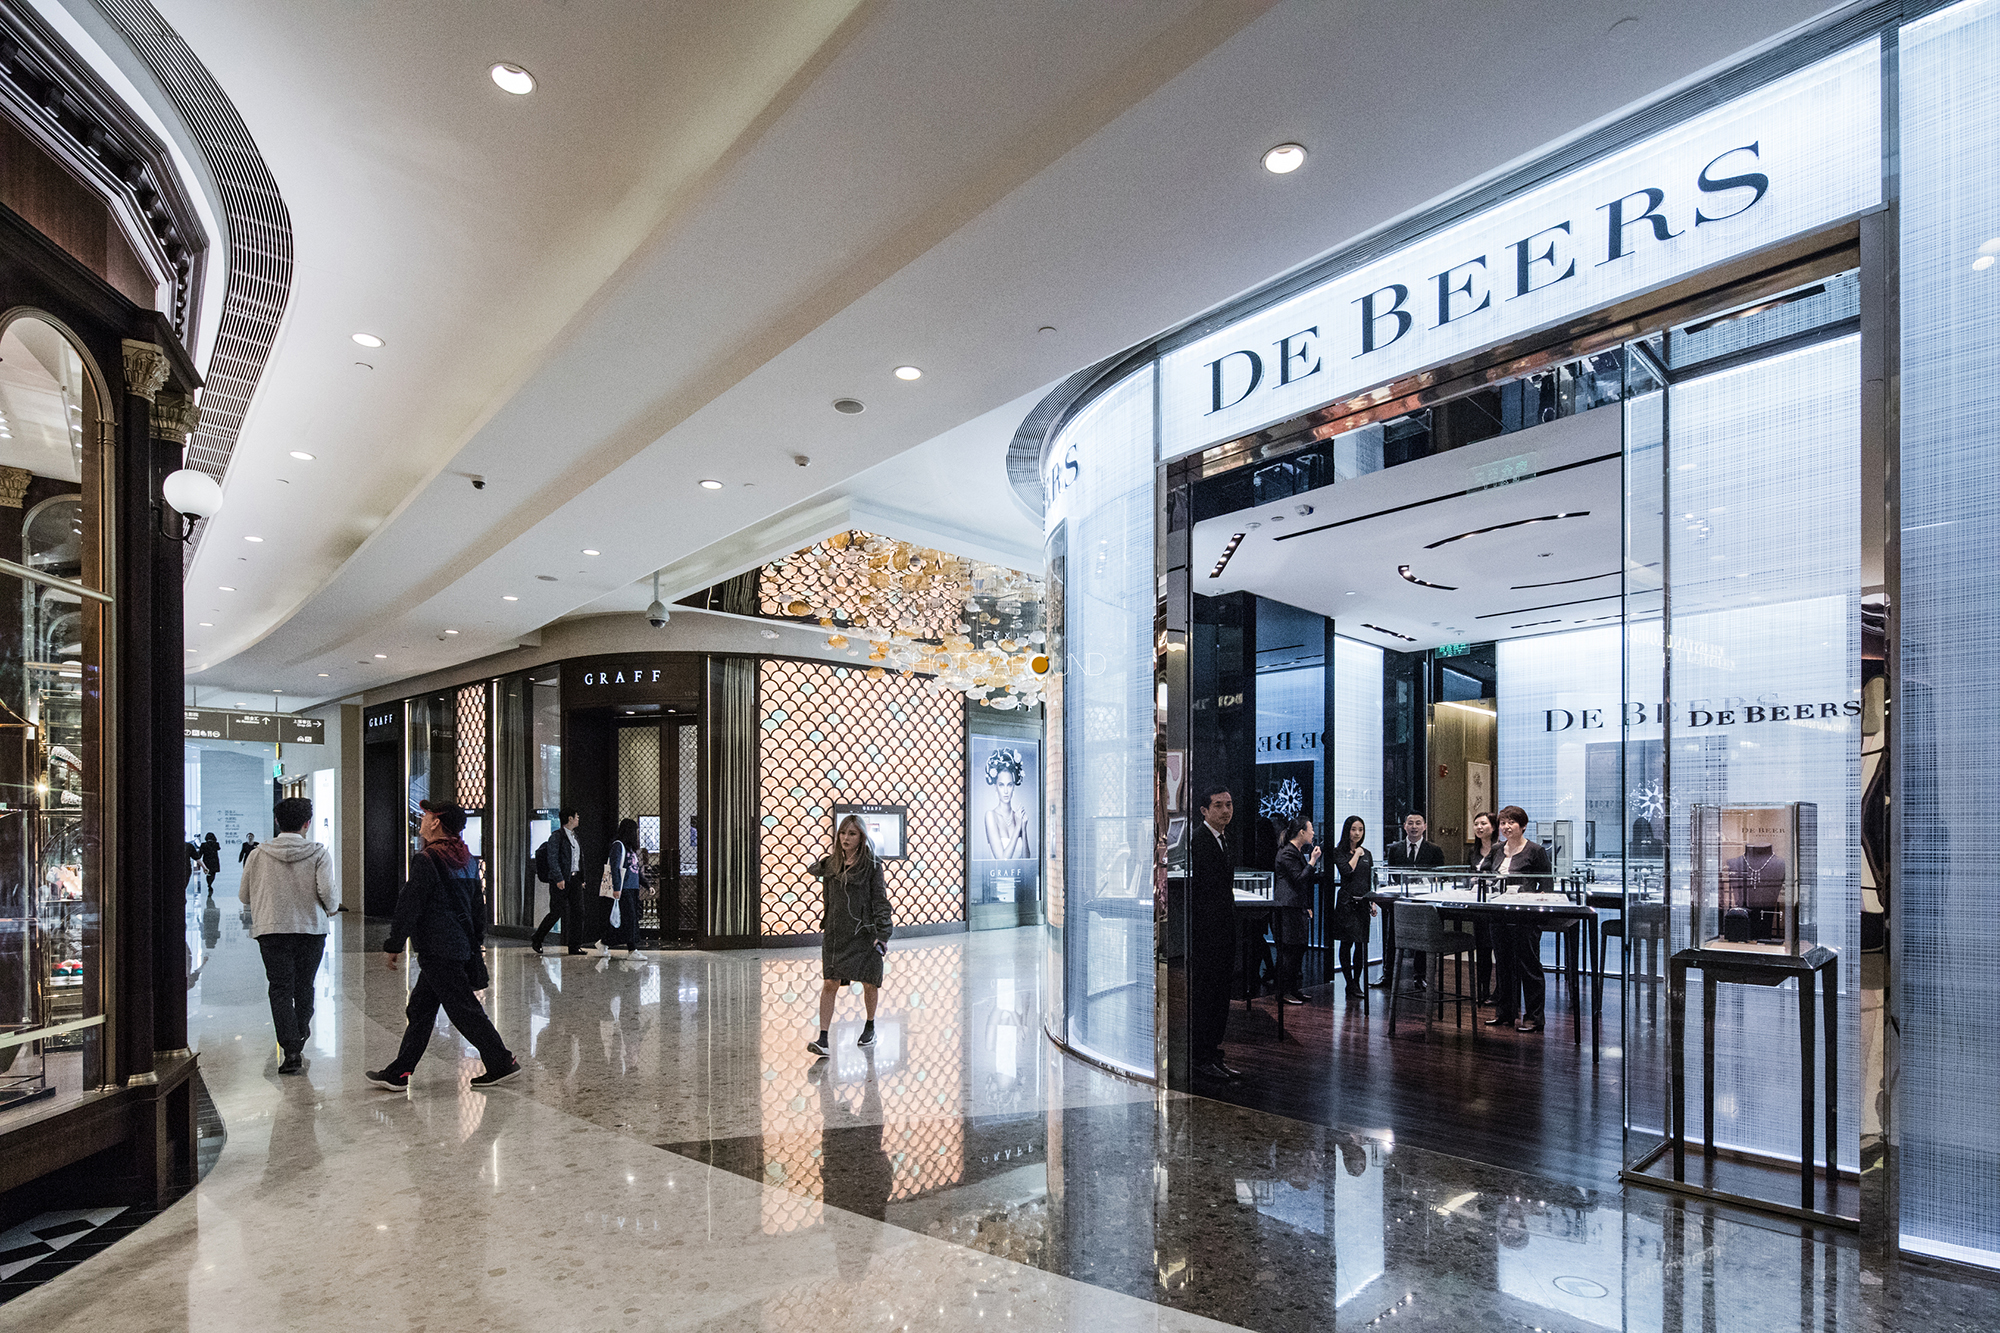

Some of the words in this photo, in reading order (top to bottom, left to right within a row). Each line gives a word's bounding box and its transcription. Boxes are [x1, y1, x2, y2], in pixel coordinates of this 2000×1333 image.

[1204, 326, 1321, 417] DE
[1350, 140, 1769, 360] BEERS
[584, 669, 661, 686] GRAFF
[369, 713, 393, 728] GRAFF
[1542, 708, 1604, 732] DE
[1688, 709, 1736, 728] DE
[1744, 700, 1861, 724] BEERS
[990, 868, 1021, 878] GRAFF
